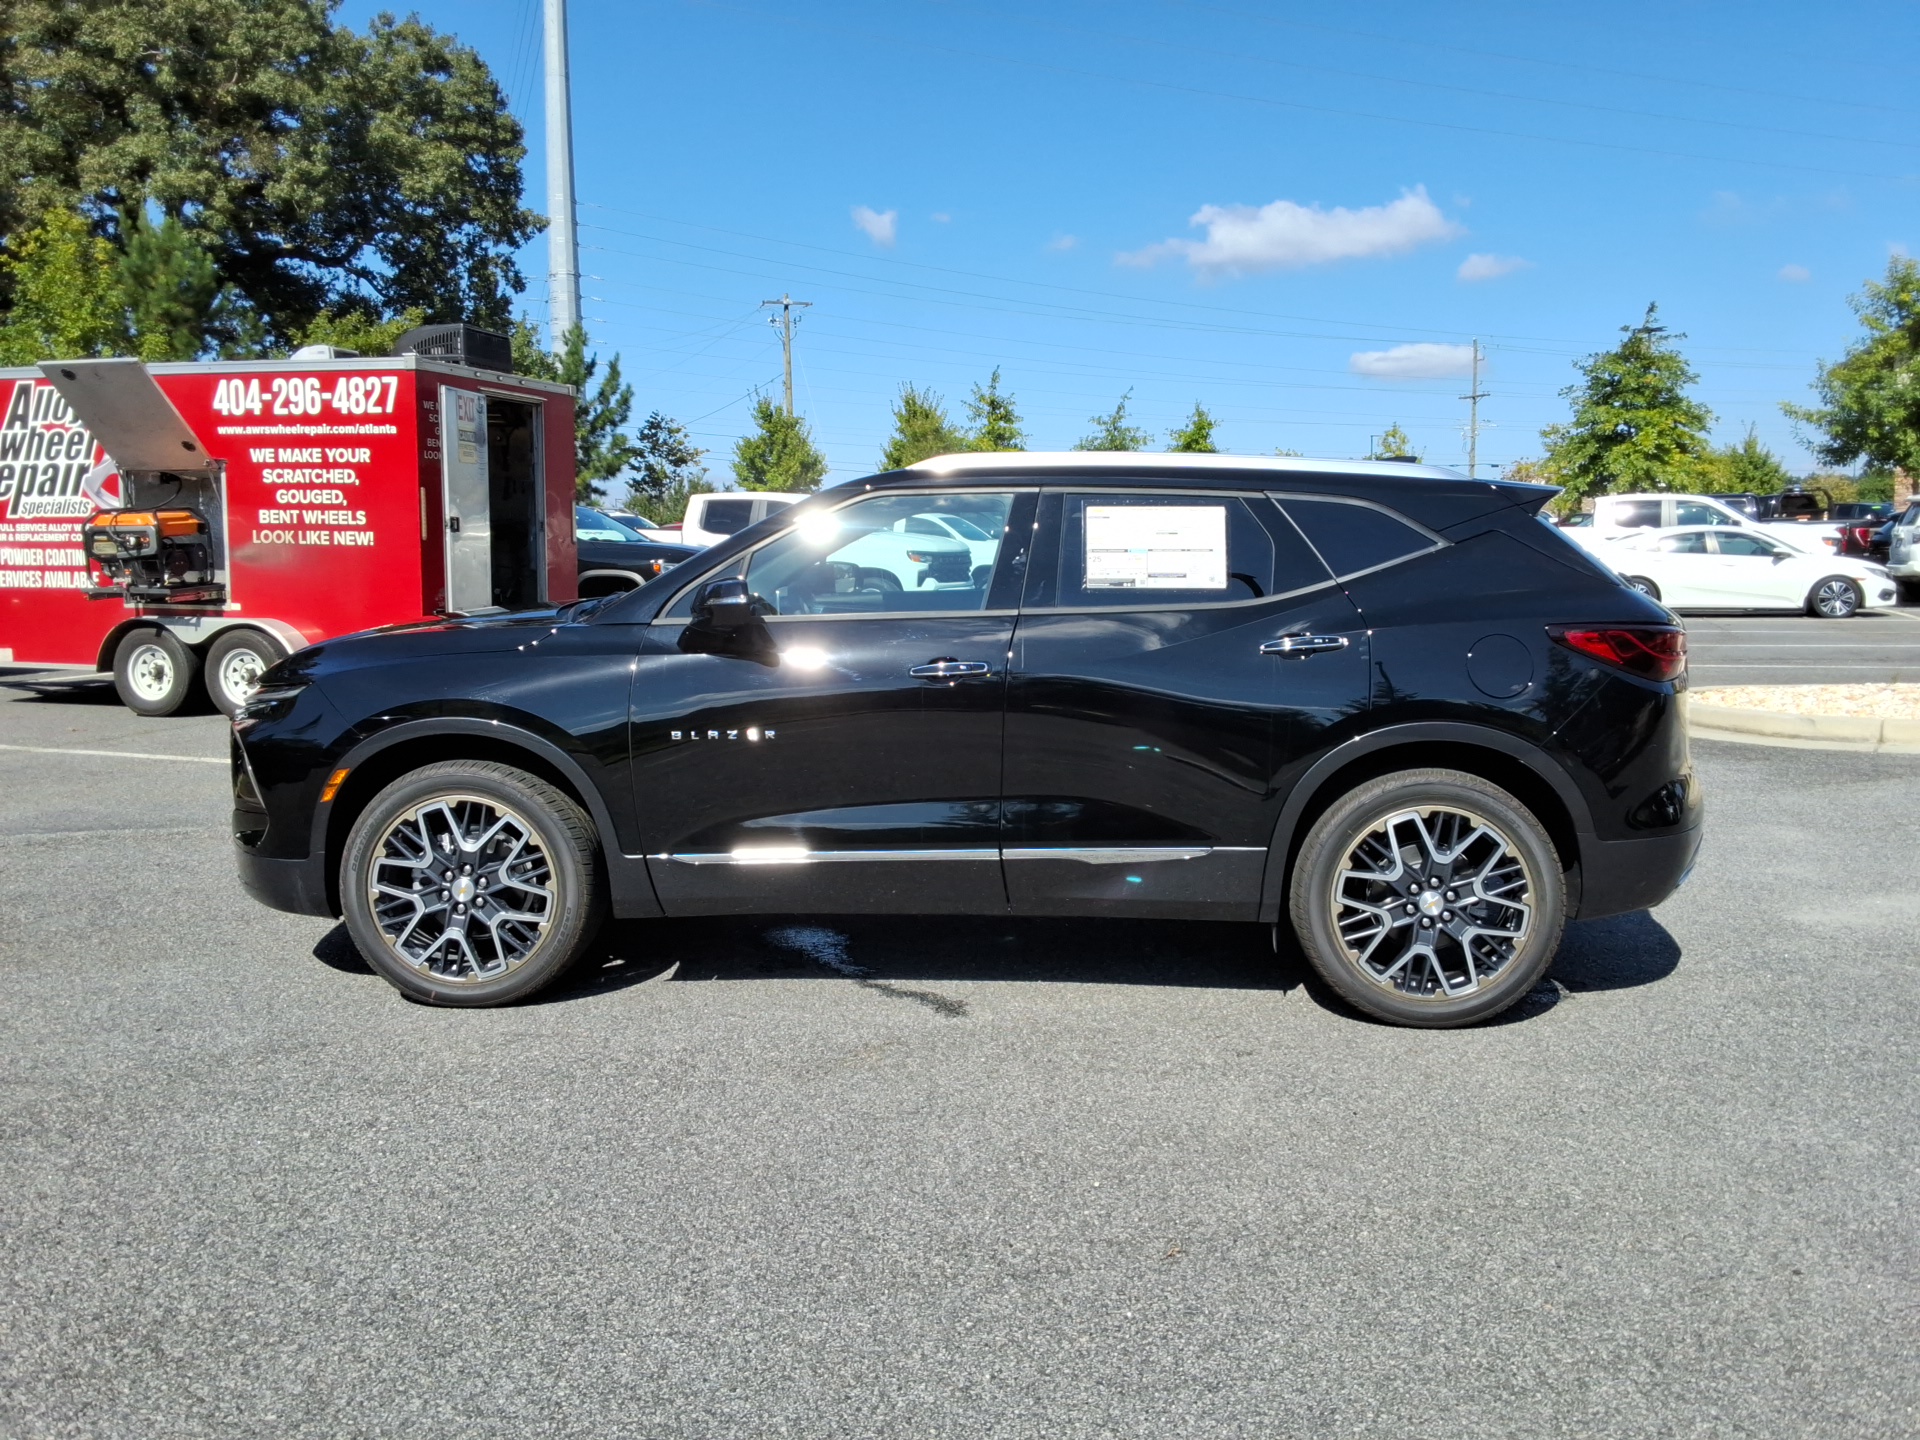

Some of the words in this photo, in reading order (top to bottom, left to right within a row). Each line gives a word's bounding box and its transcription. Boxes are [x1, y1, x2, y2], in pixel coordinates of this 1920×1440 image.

[213, 376, 398, 416] 404-296-4827
[457, 394, 475, 422] EXIT
[217, 424, 397, 436] www.awrswheelrepair.com/atlanta
[0, 424, 96, 462] wheel
[250, 448, 275, 463] WE
[278, 448, 322, 463] MAKE
[325, 448, 371, 463] YOUR
[262, 469, 360, 486] SCRATCHED,
[0, 462, 92, 516] epair
[275, 489, 348, 506] GOUGED,
[21, 498, 90, 516] specialists
[258, 509, 300, 525] BENT
[303, 510, 367, 525] WHEELS
[0, 523, 14, 532] ULL
[15, 523, 47, 532] SERVICE
[48, 523, 73, 532] ALLOY
[15, 533, 70, 542] REPLACEMENT
[252, 530, 295, 544] LOOK
[298, 531, 330, 545] LIKE
[333, 531, 374, 546] NEW!
[0, 548, 44, 566] POWDER
[45, 549, 87, 566] COATIN
[0, 570, 43, 588] ERVICES
